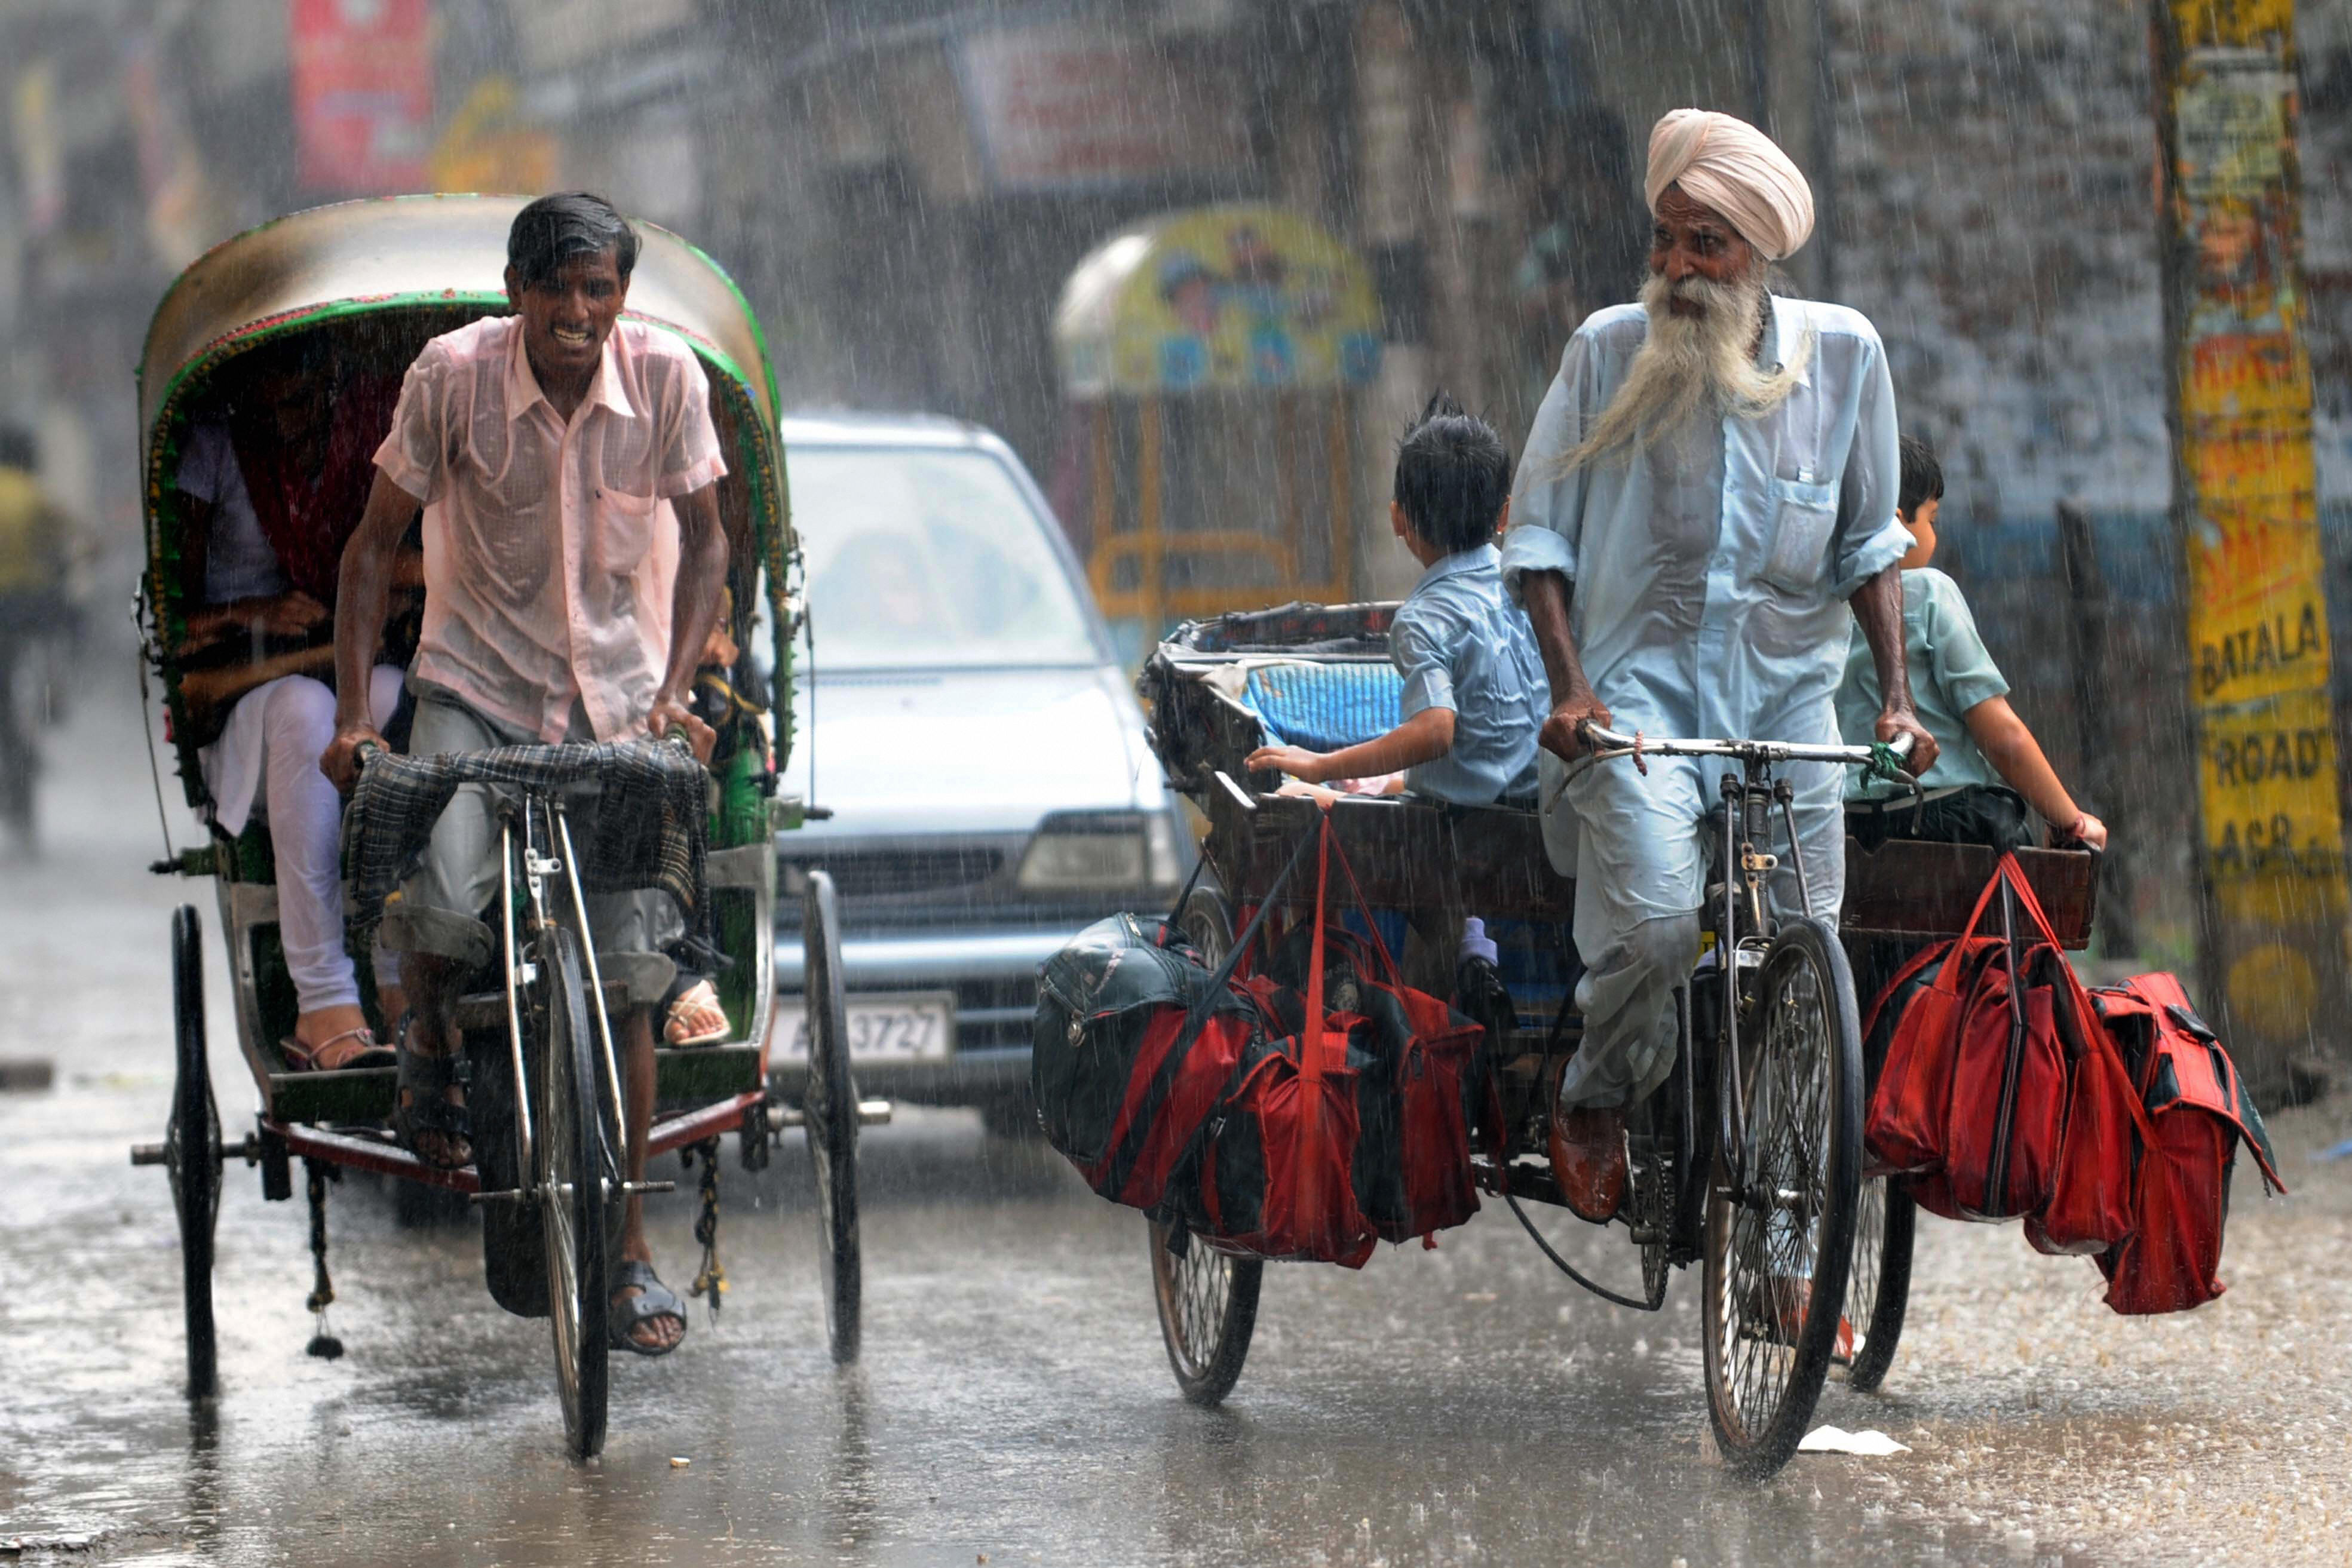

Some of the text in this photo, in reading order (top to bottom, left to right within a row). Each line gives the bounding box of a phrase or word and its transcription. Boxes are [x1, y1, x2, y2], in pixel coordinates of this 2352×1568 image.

[2201, 602, 2320, 695] BATALA
[2215, 730, 2319, 786] ROAD
[852, 1011, 936, 1050] 3727
